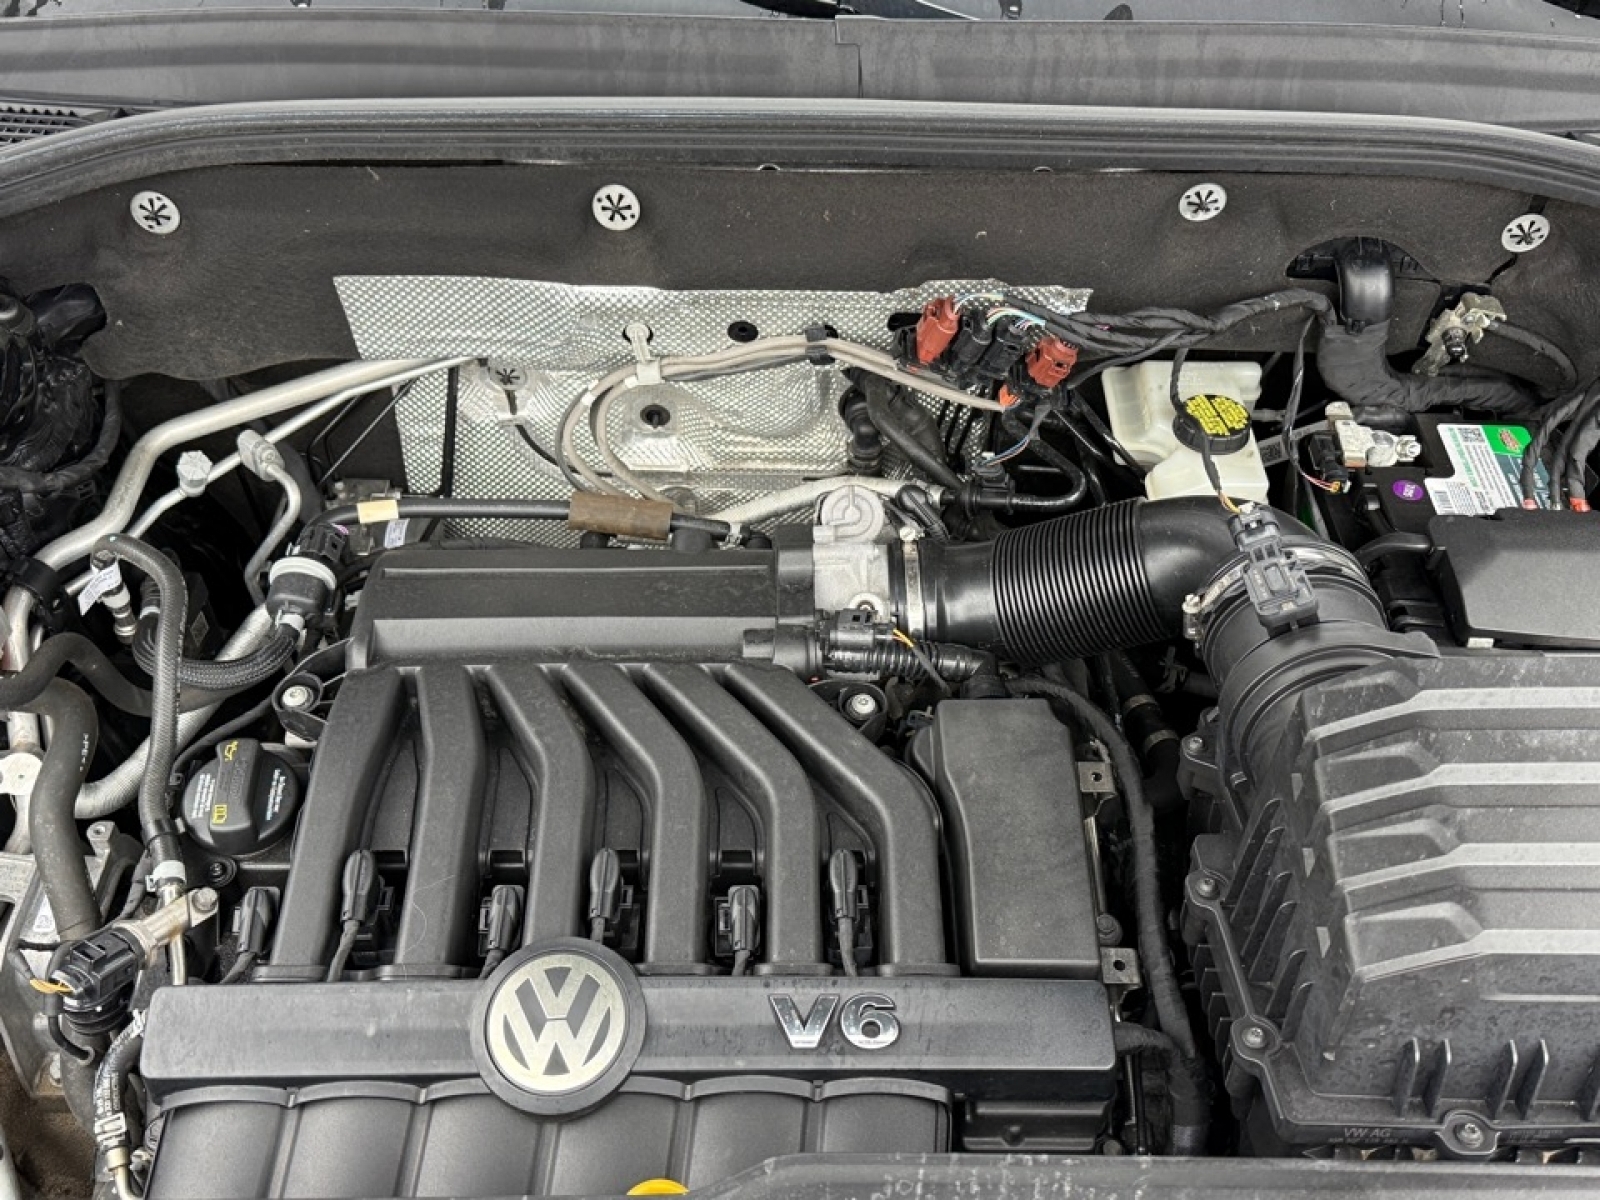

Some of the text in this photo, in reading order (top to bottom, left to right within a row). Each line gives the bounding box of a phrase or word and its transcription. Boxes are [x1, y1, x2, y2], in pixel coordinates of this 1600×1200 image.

[487, 953, 627, 1095] VW
[768, 993, 901, 1050] V6
[1344, 1127, 1391, 1138] VW AG
